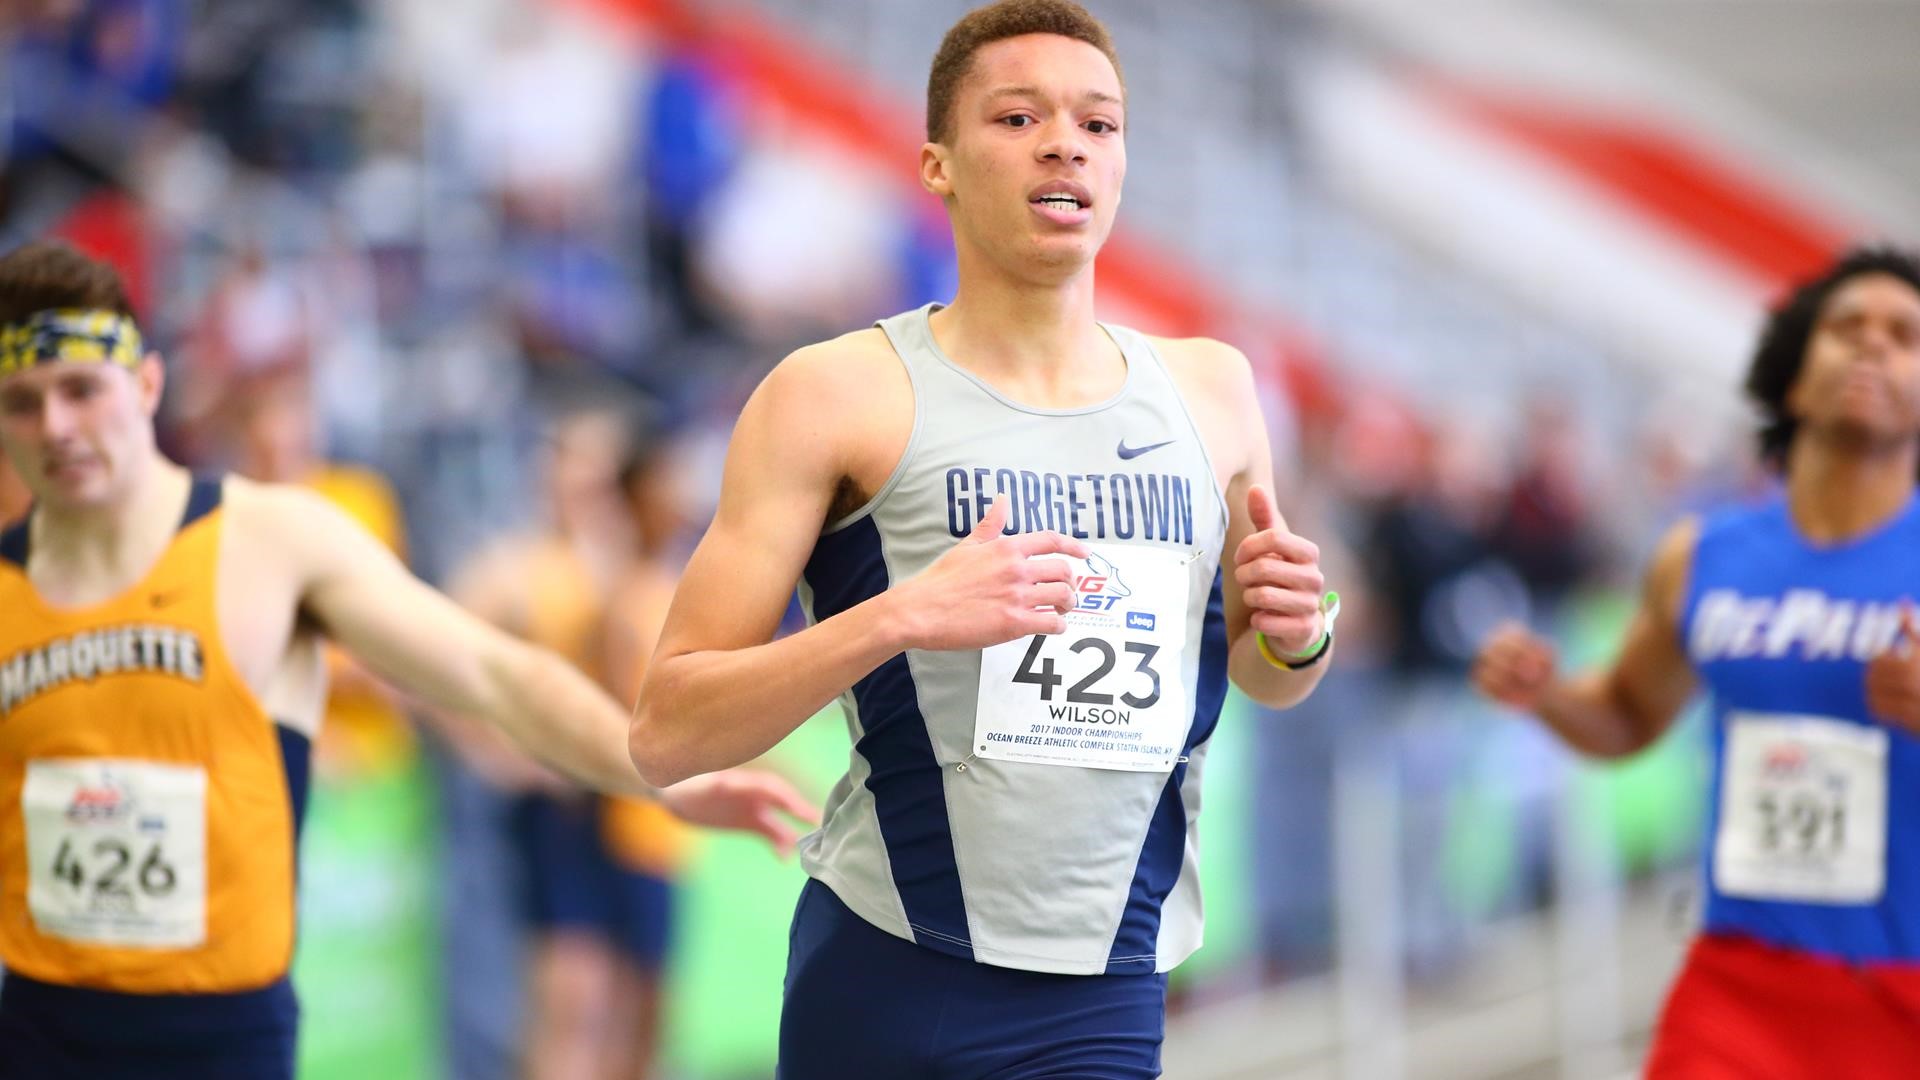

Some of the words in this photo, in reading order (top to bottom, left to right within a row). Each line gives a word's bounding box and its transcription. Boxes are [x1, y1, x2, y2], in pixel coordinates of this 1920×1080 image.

[946, 467, 1193, 546] GEORGETOWN
[1129, 614, 1153, 629] Jeep
[0, 623, 206, 717] MARQUETTE
[1011, 634, 1161, 709] 423
[1030, 723, 1051, 735] 2017
[1052, 725, 1083, 737] INDOOR
[1084, 727, 1143, 741] CHAMPIONSHIPS
[1048, 704, 1131, 725] WILSON
[986, 732, 1014, 743] OCEAN
[1014, 734, 1043, 746] BREEZE
[1043, 737, 1078, 748] ATHLETIC
[1079, 740, 1114, 751] COMPLEX
[1116, 743, 1139, 753] STATEN
[52, 838, 177, 898] 426
